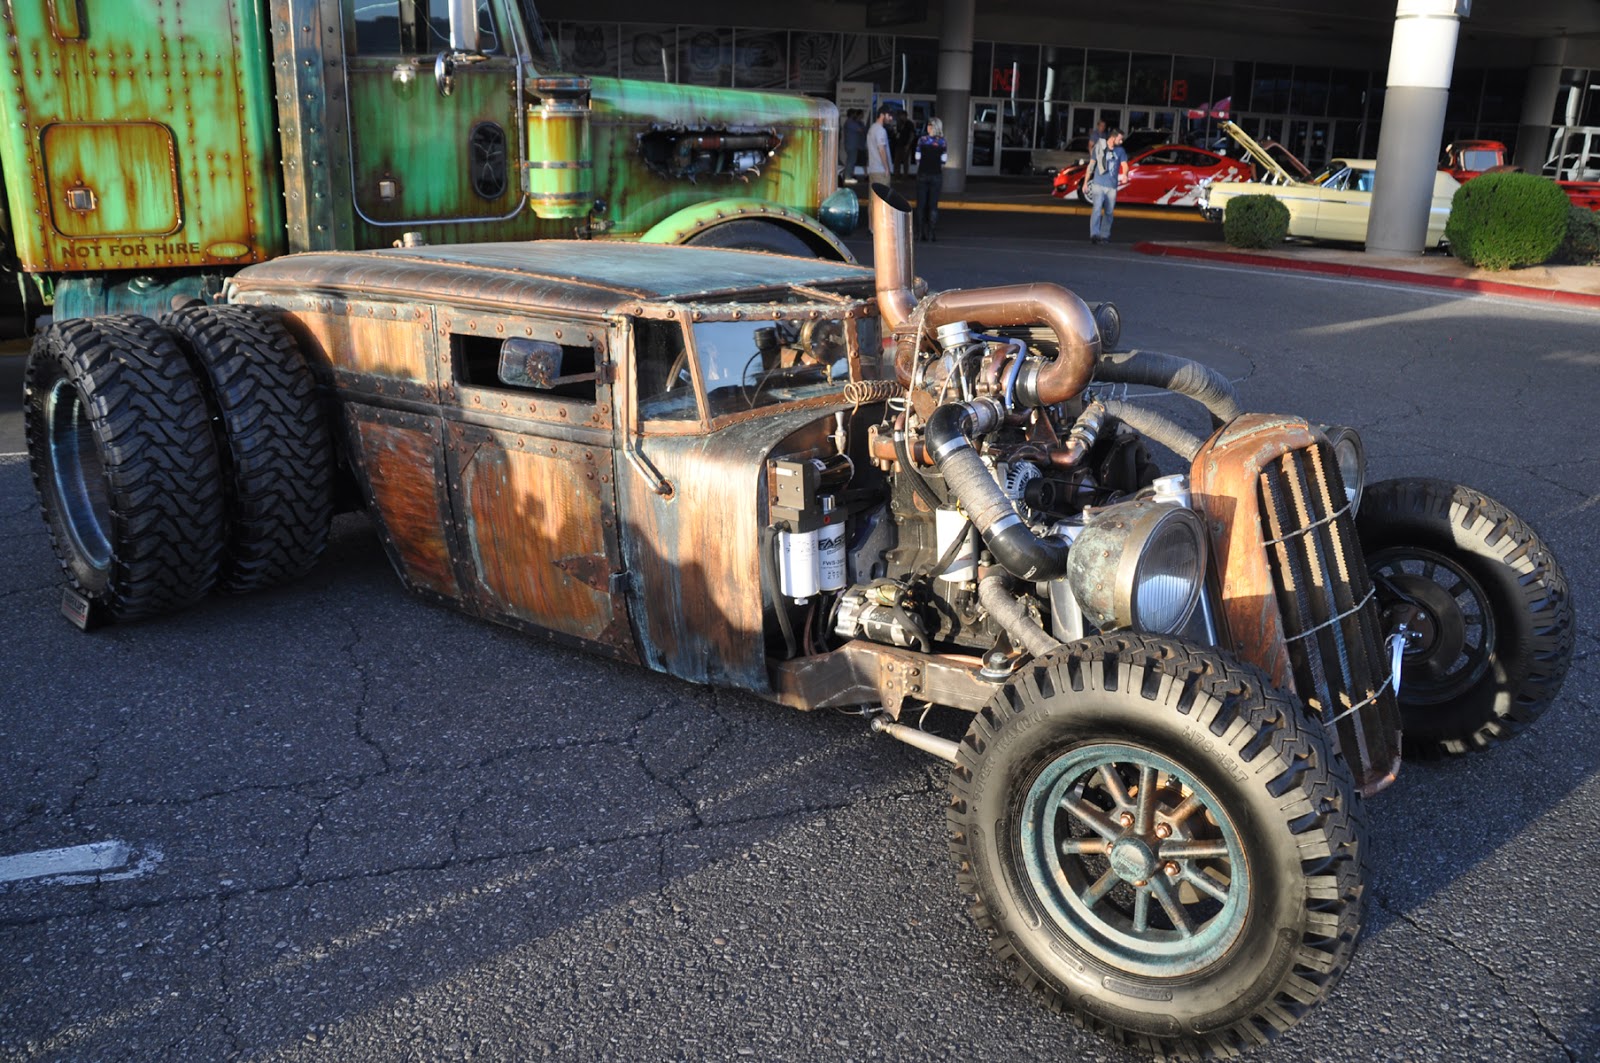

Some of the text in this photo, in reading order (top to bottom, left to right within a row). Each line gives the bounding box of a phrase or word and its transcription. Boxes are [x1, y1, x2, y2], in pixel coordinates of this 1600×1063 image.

[61, 242, 200, 258] NOT FOR HIRE
[972, 756, 995, 802] SUPER
